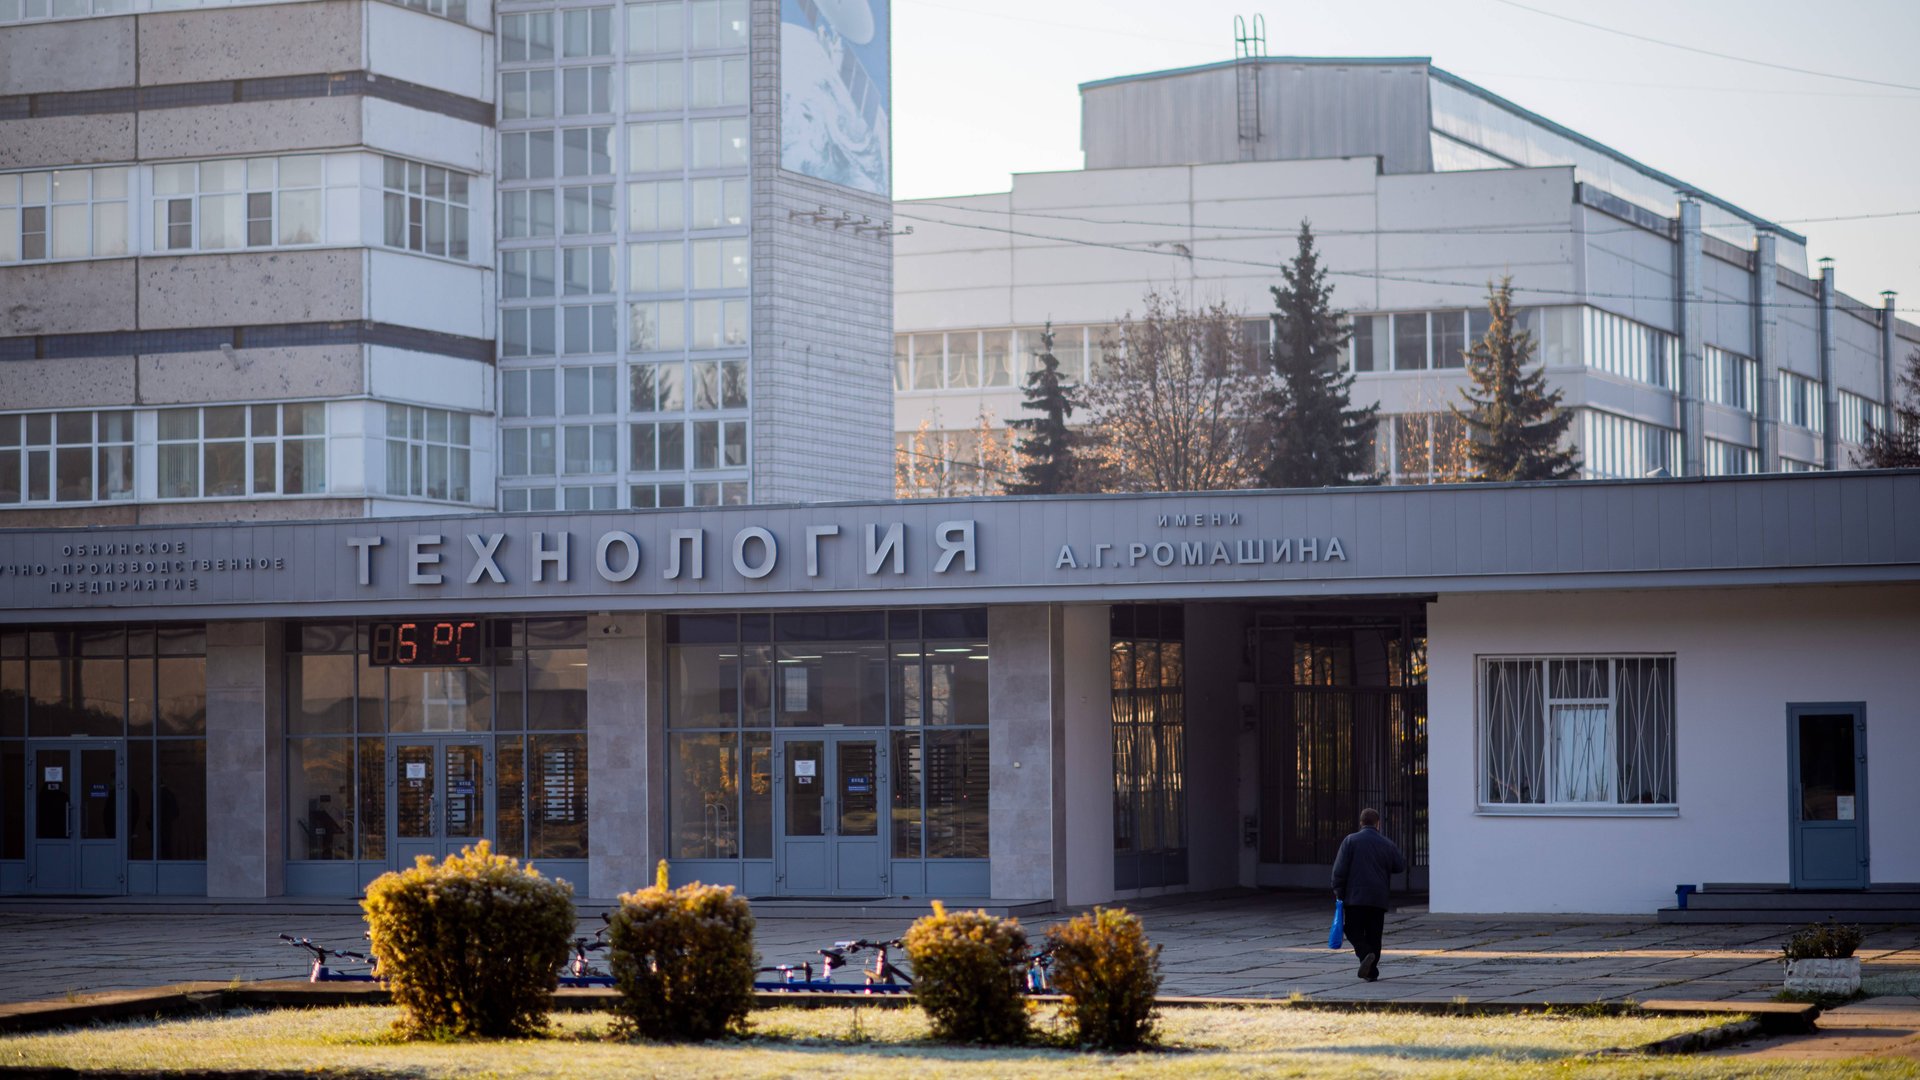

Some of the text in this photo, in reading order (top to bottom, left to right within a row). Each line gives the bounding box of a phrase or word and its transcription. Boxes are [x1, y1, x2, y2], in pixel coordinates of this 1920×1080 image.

[1158, 512, 1241, 527] ИМЕНИ
[62, 542, 185, 557] ОБНИНСКОЕ
[346, 519, 977, 585] ТЕХНОЛОГИЯ
[0, 558, 284, 577] ЧНО-ПРОИЗВОДСТВЕННОЕ
[50, 578, 198, 594] ПРЕДПРИЯТИЕ
